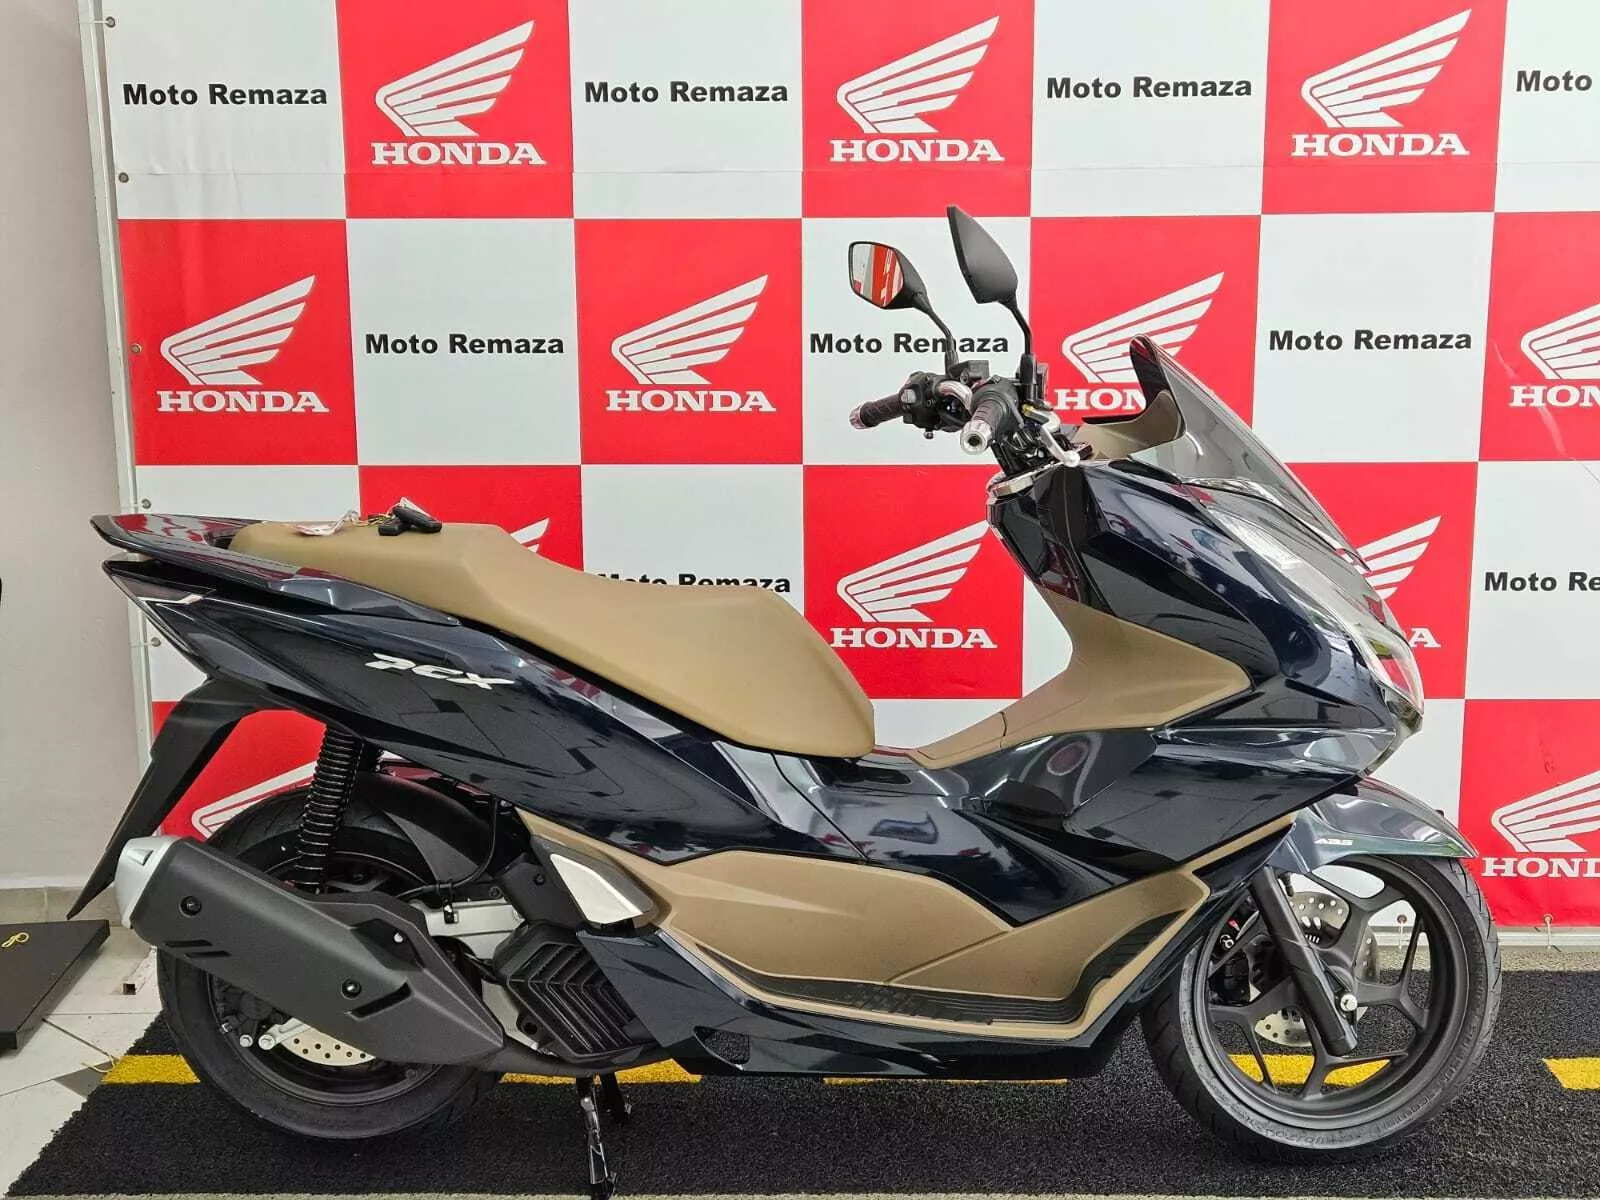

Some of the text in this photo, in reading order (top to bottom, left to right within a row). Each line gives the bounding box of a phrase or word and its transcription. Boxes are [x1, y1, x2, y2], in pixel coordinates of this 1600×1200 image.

[584, 81, 788, 102] Moto Remaza
[1047, 76, 1252, 98] Moto Remaza
[1516, 70, 1593, 92] Moto
[122, 83, 327, 105] Moto Remaza
[371, 141, 547, 165] HONDA
[829, 138, 1005, 162] HONDA
[1291, 132, 1470, 157] HONDA
[365, 333, 564, 354] Moto Remaza
[810, 333, 1009, 353] Moto Remaza
[1269, 329, 1472, 351] Moto Remaza
[156, 390, 329, 413] HONDA
[606, 389, 777, 412] HONDA
[1053, 388, 1147, 411] HON
[1484, 571, 1557, 592] Moto
[829, 627, 998, 649] HONDA
[364, 652, 516, 690] PCX
